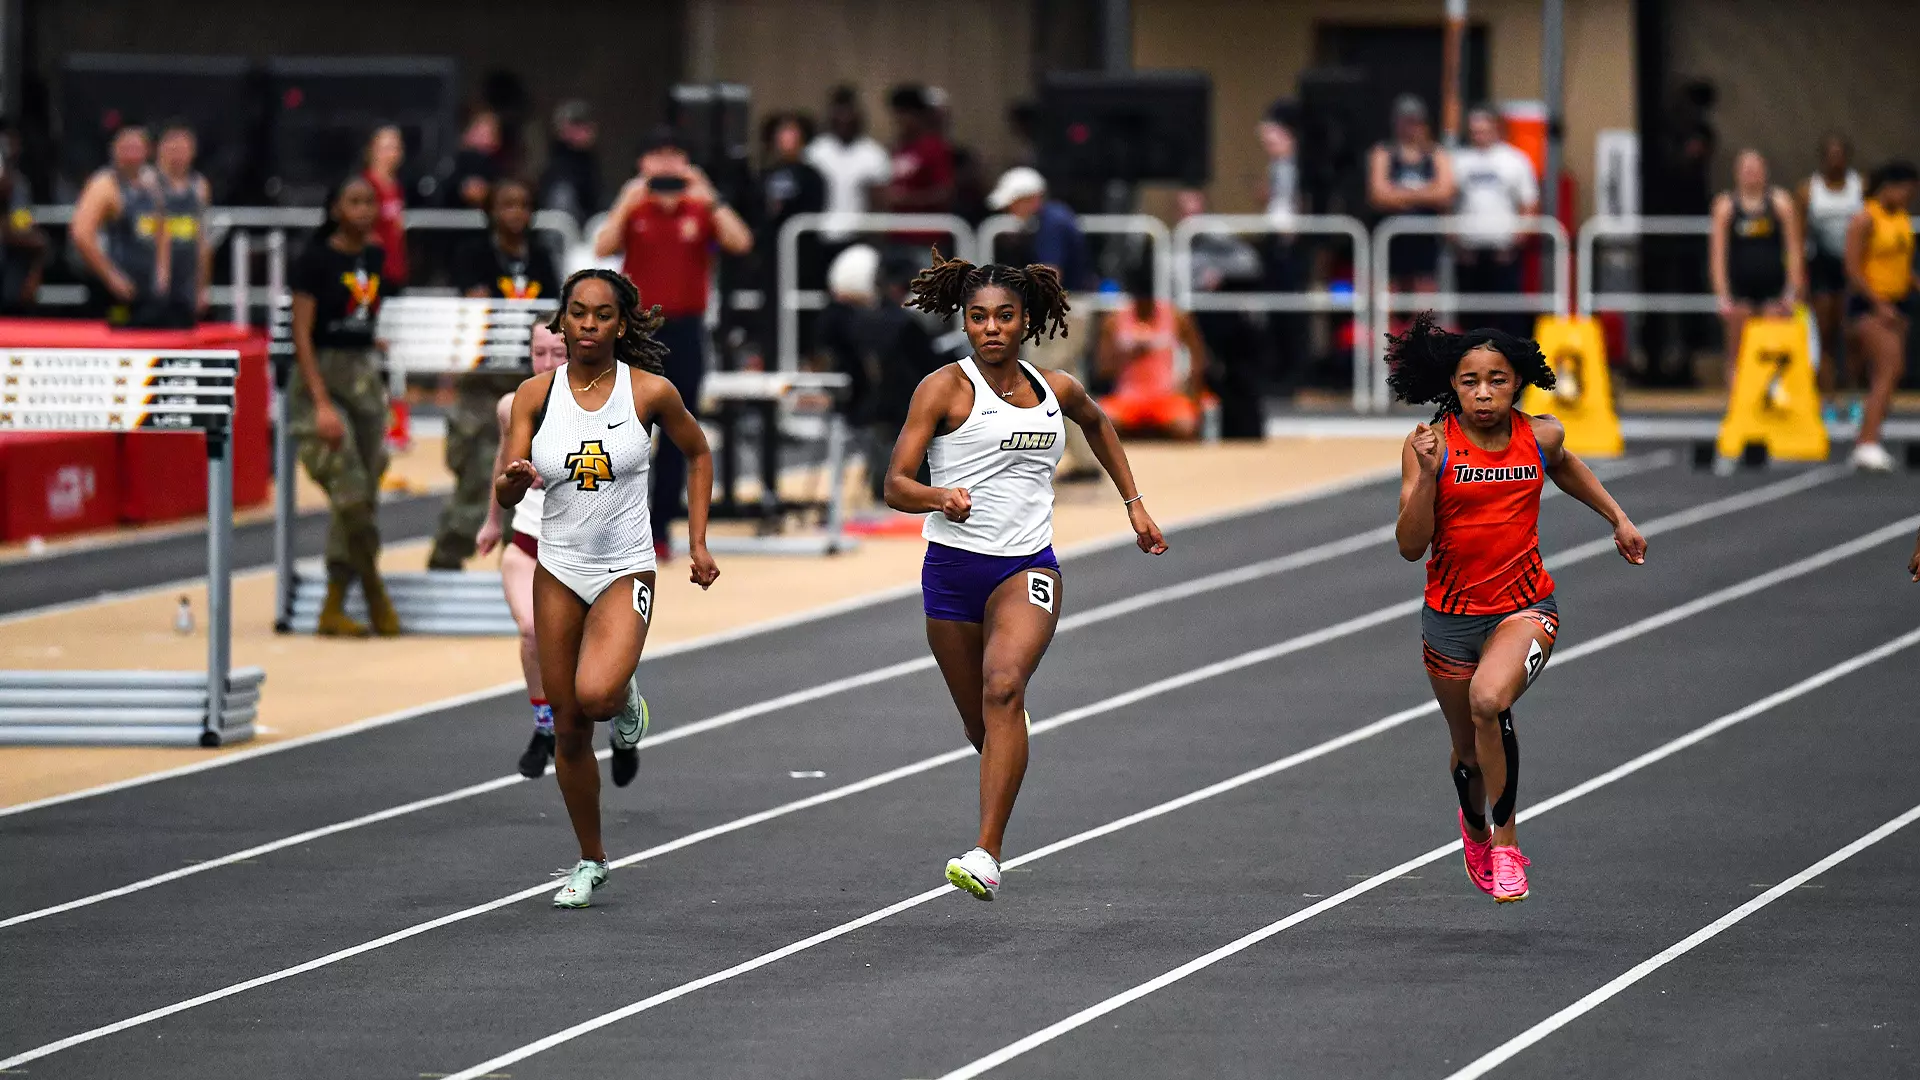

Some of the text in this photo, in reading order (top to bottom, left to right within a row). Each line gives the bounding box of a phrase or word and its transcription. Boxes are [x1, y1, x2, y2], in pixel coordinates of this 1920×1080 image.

[1758, 348, 1792, 410] 7
[1000, 432, 1057, 451] JMU
[1453, 463, 1538, 485] TUSCULUM
[637, 585, 648, 616] 6
[1032, 577, 1050, 603] 5
